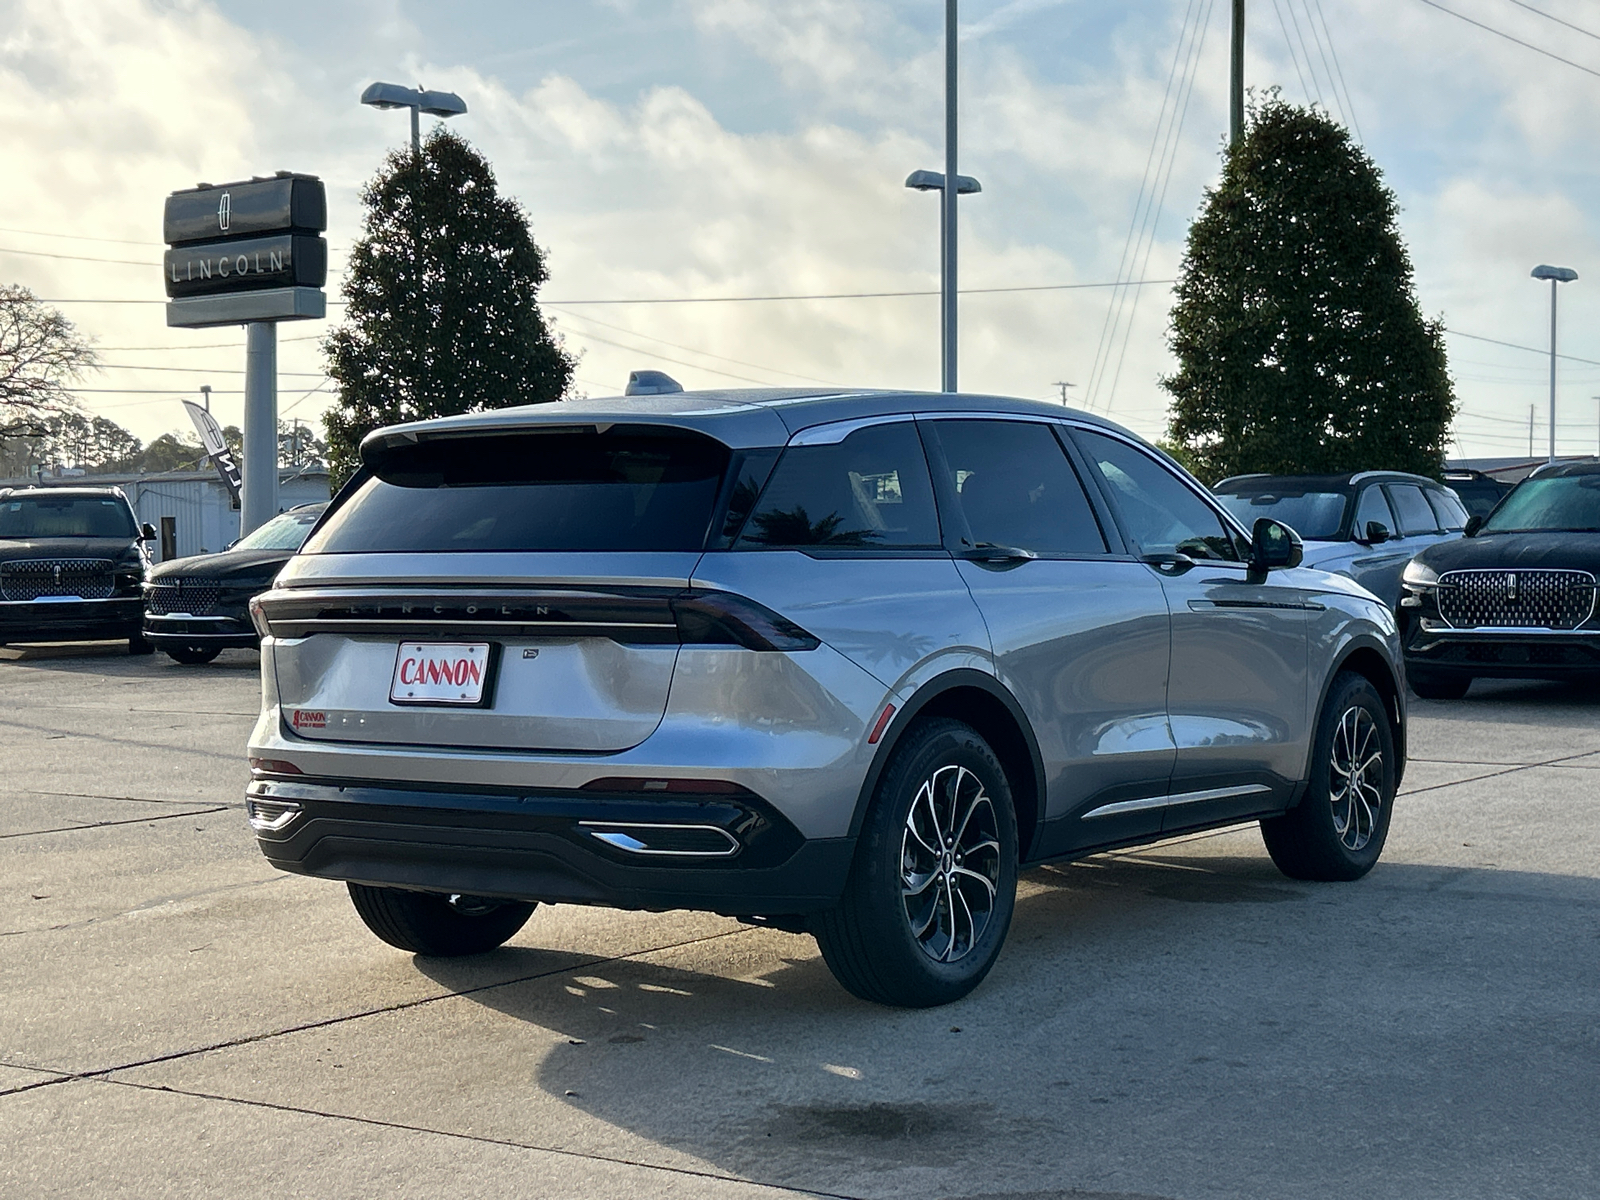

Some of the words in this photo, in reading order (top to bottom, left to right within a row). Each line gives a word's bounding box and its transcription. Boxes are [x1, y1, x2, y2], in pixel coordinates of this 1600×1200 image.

[172, 250, 283, 283] LINCOLN
[350, 605, 549, 616] LINCOLN
[400, 657, 484, 687] CANNON
